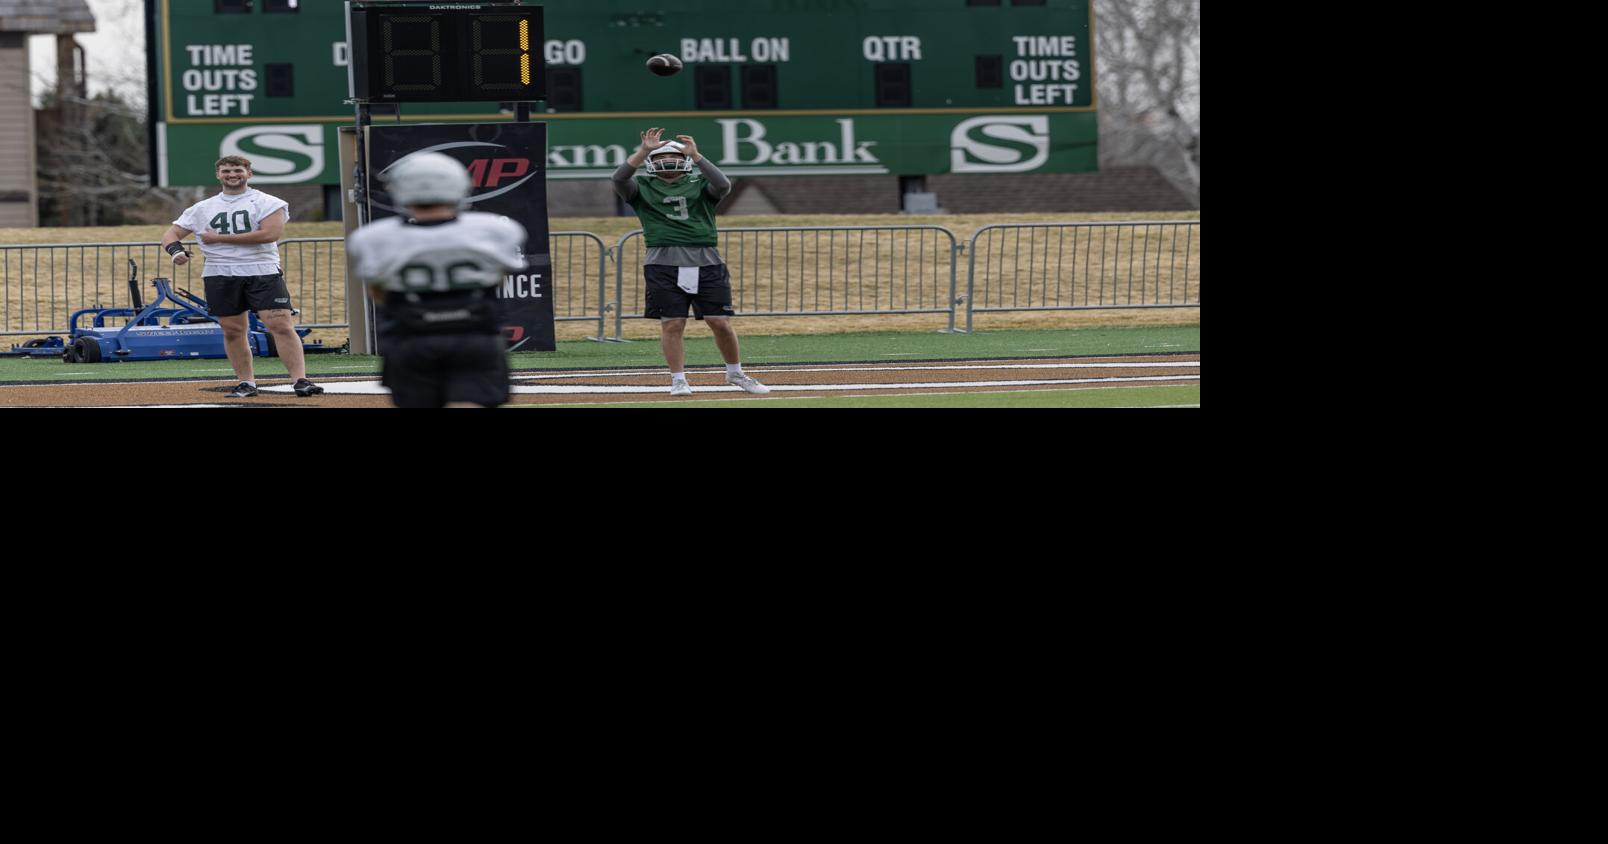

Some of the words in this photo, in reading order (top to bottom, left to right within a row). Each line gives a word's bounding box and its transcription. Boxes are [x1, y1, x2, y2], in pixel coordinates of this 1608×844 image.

[186, 44, 253, 66] TIME
[544, 39, 586, 65] GO
[681, 38, 747, 62] BALL
[751, 37, 789, 62] ON
[863, 36, 922, 61] QTR
[1012, 36, 1075, 57] TIME
[182, 68, 257, 91] OUTS
[1010, 59, 1080, 81] OUTS
[187, 94, 254, 116] LEFT
[1015, 84, 1077, 105] LEFT
[714, 117, 879, 165] Bank
[662, 195, 690, 221] 3
[209, 209, 252, 235] 40
